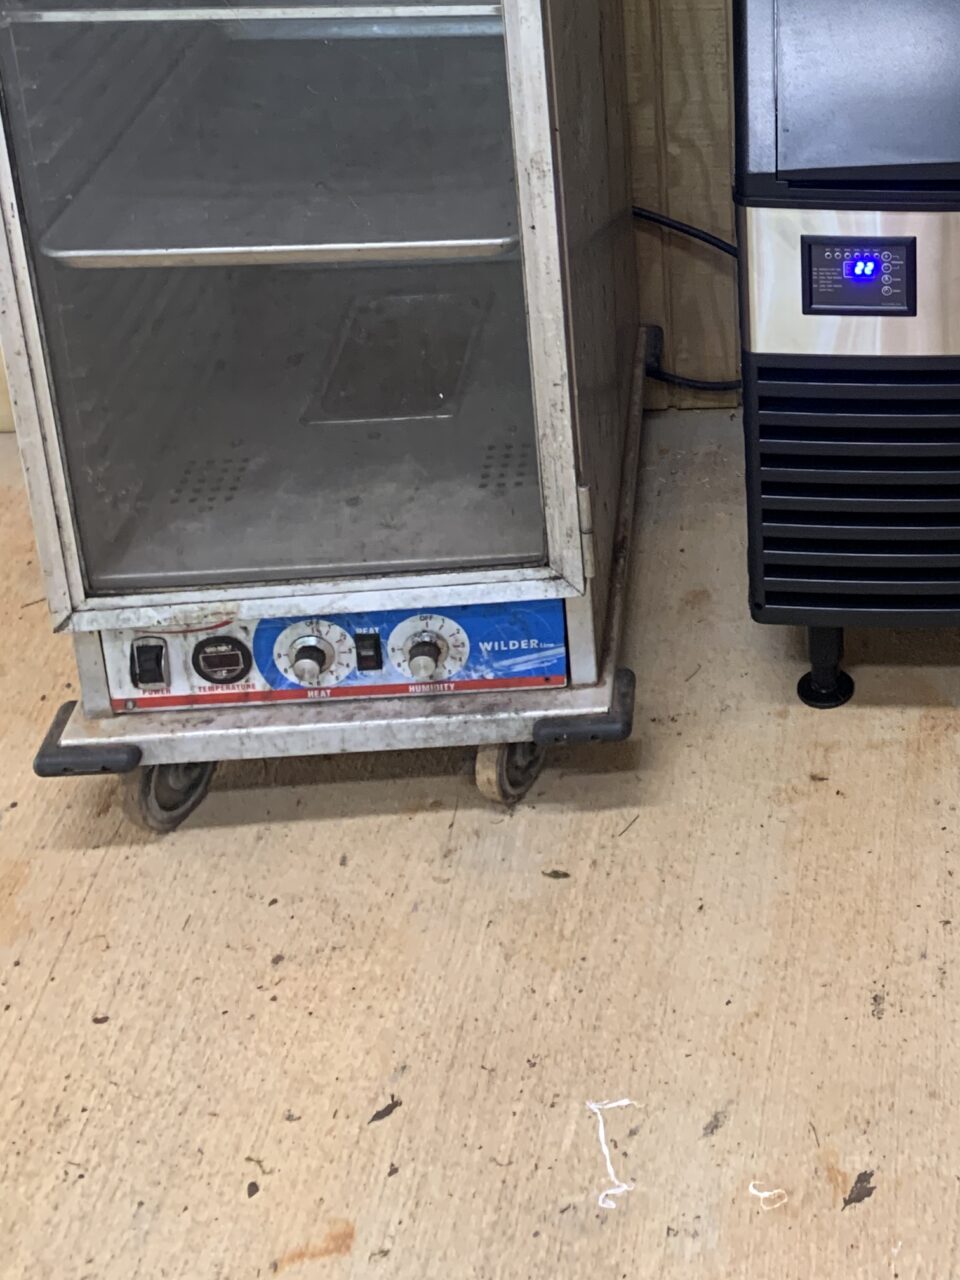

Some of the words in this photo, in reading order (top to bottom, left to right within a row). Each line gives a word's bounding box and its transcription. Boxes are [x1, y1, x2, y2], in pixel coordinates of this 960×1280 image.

[478, 639, 539, 651] WILDER
[142, 687, 171, 695] POWER
[197, 683, 257, 693] TEMPERATURE
[408, 682, 455, 693] HUMIDITY
[307, 689, 331, 699] HEAT
